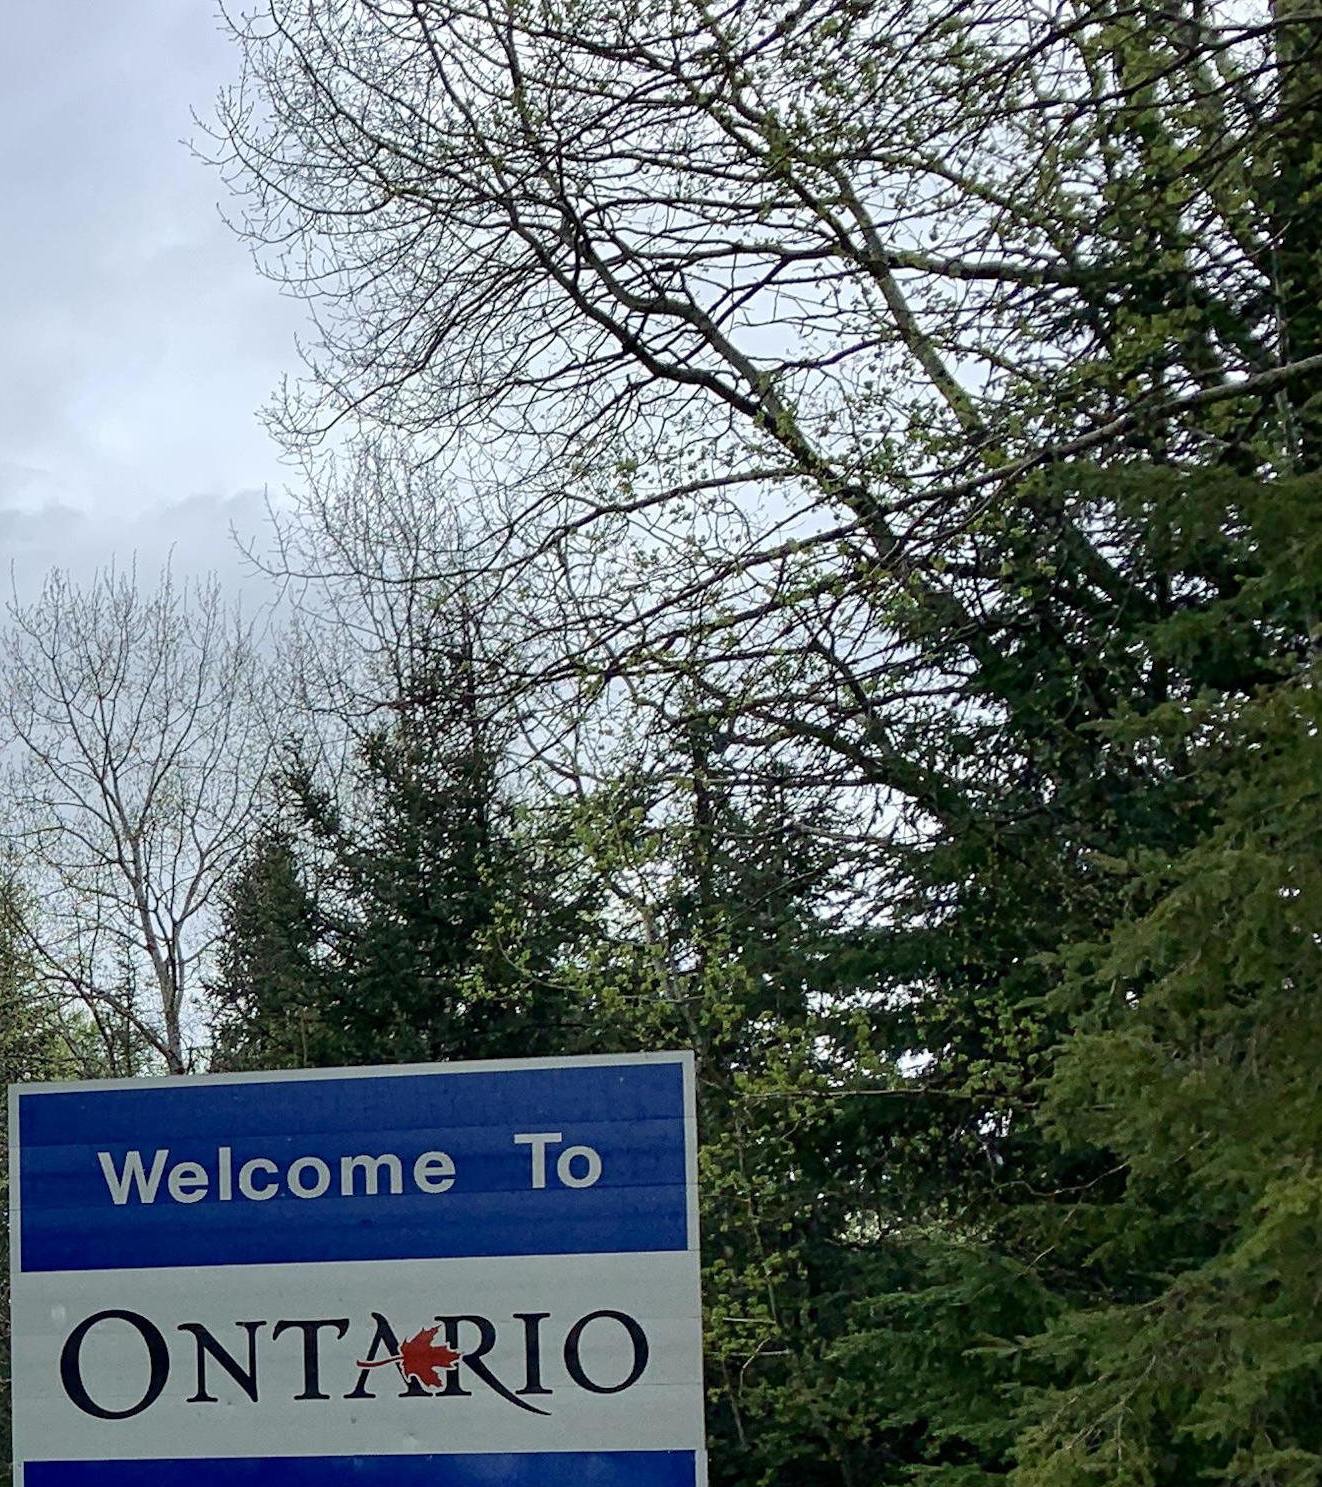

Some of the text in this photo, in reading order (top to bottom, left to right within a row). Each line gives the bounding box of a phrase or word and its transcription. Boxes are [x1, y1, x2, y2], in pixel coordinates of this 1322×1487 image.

[98, 1132, 603, 1205] Welcome To
[59, 1309, 649, 1419] ONTARIO
